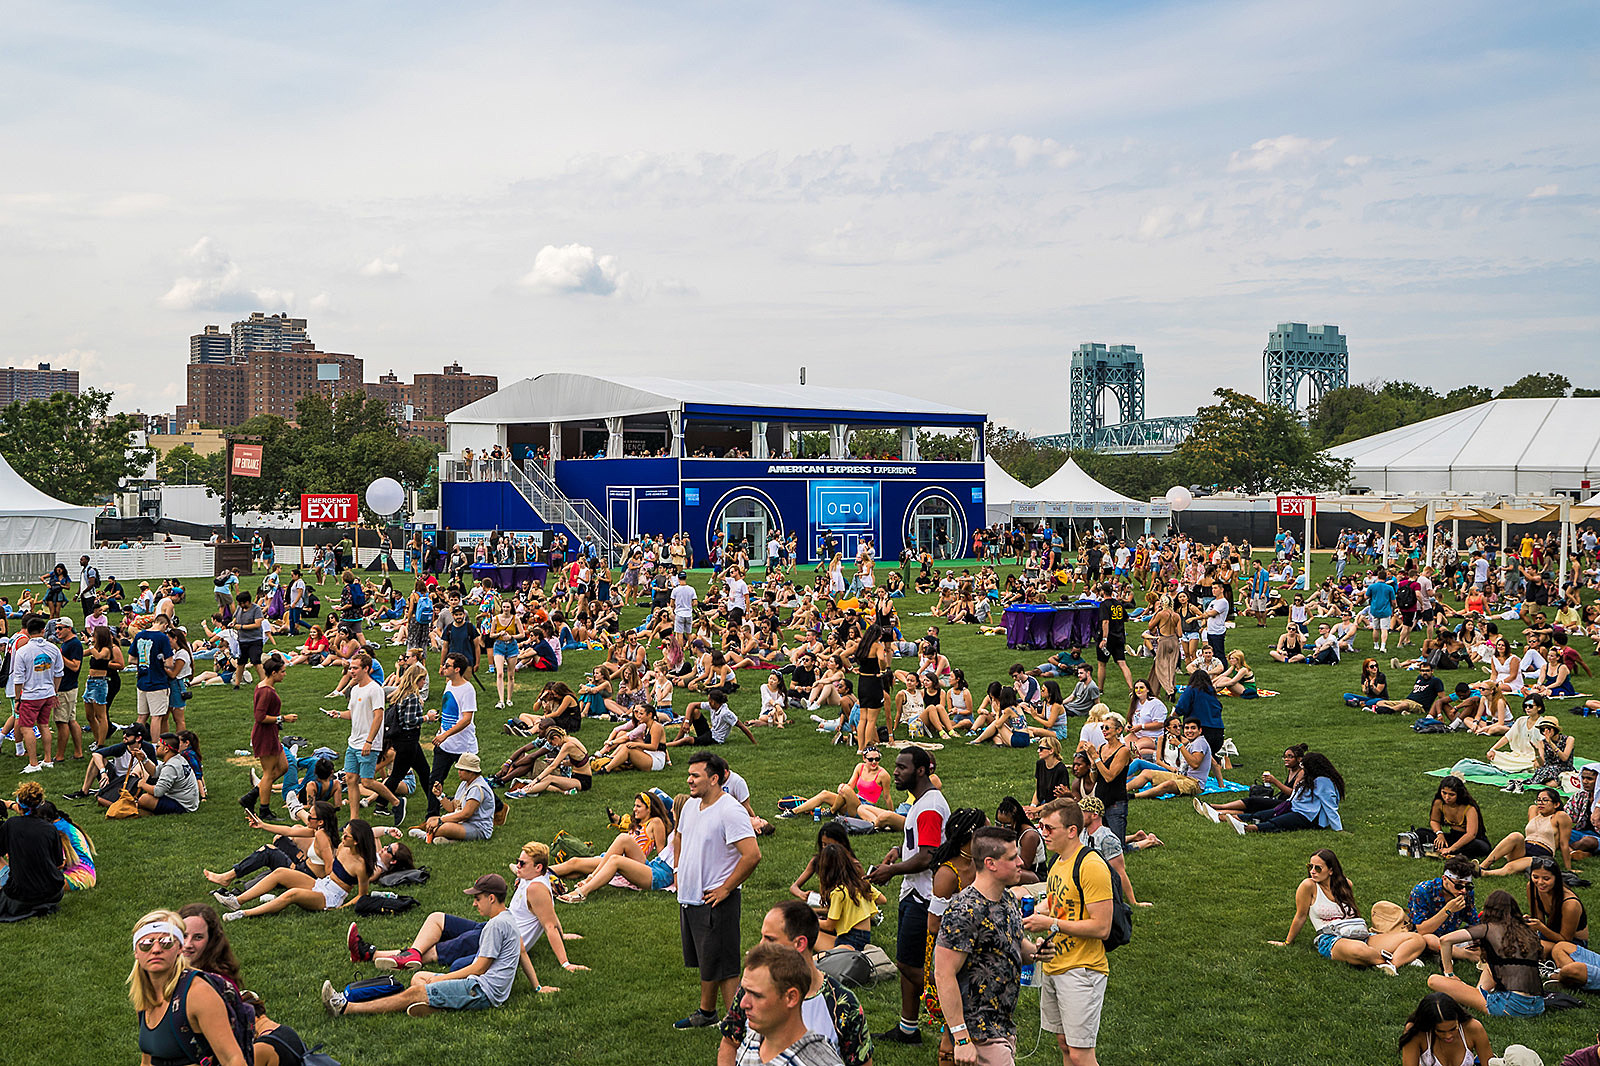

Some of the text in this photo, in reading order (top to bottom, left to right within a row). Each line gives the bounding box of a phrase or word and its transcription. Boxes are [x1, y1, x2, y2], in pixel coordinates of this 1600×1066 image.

[241, 458, 259, 470] ENTRANCE
[767, 465, 917, 475] AMERICAN EXPRESS EXPERIENCE
[307, 503, 351, 519] EXIT
